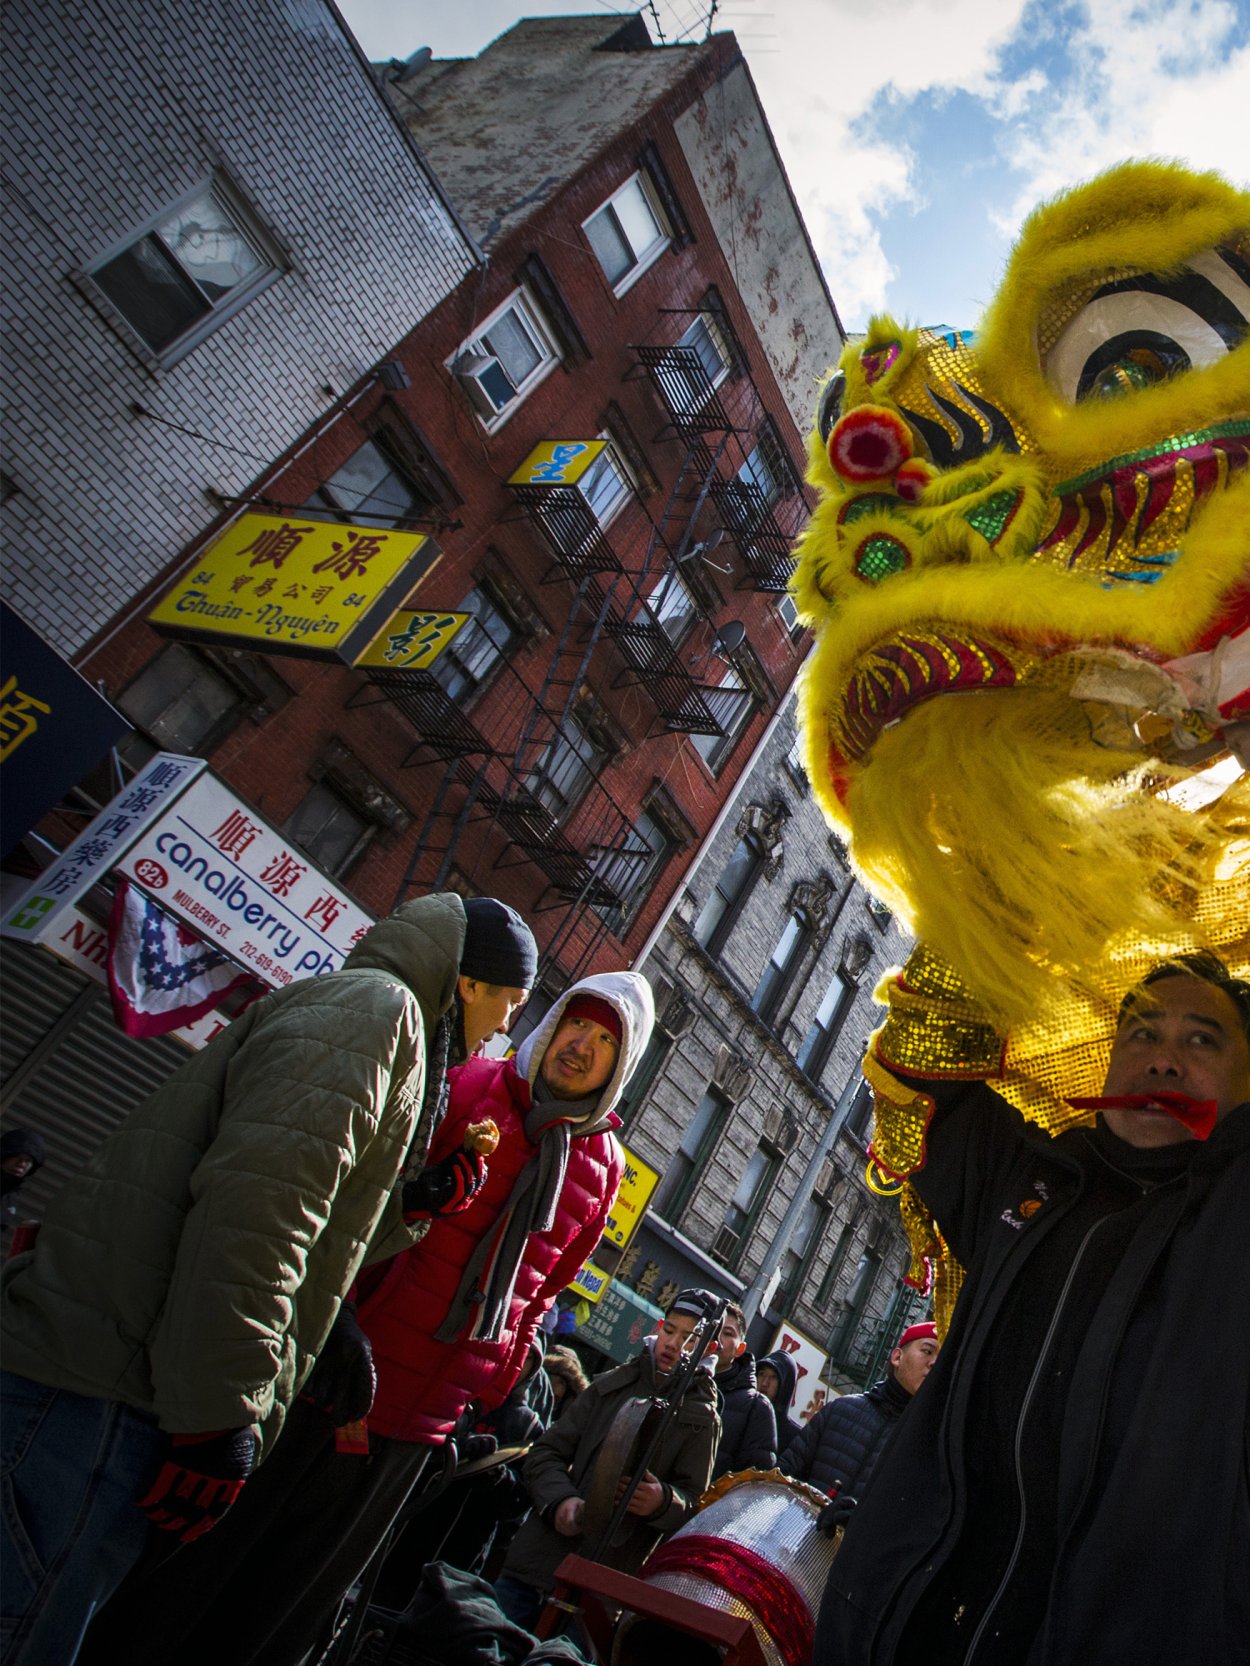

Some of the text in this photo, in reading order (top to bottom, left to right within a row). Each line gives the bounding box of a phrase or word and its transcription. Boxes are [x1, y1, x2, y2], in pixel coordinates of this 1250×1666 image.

[236, 523, 389, 581] 順源
[191, 571, 367, 608] 84 貿易公司 84
[383, 614, 456, 667] 影
[40, 761, 188, 895] 順源西藥房
[155, 832, 336, 976] canalberry ph
[172, 889, 220, 929] MULBERRY
[216, 924, 232, 940] ST.
[60, 919, 109, 971] Nh
